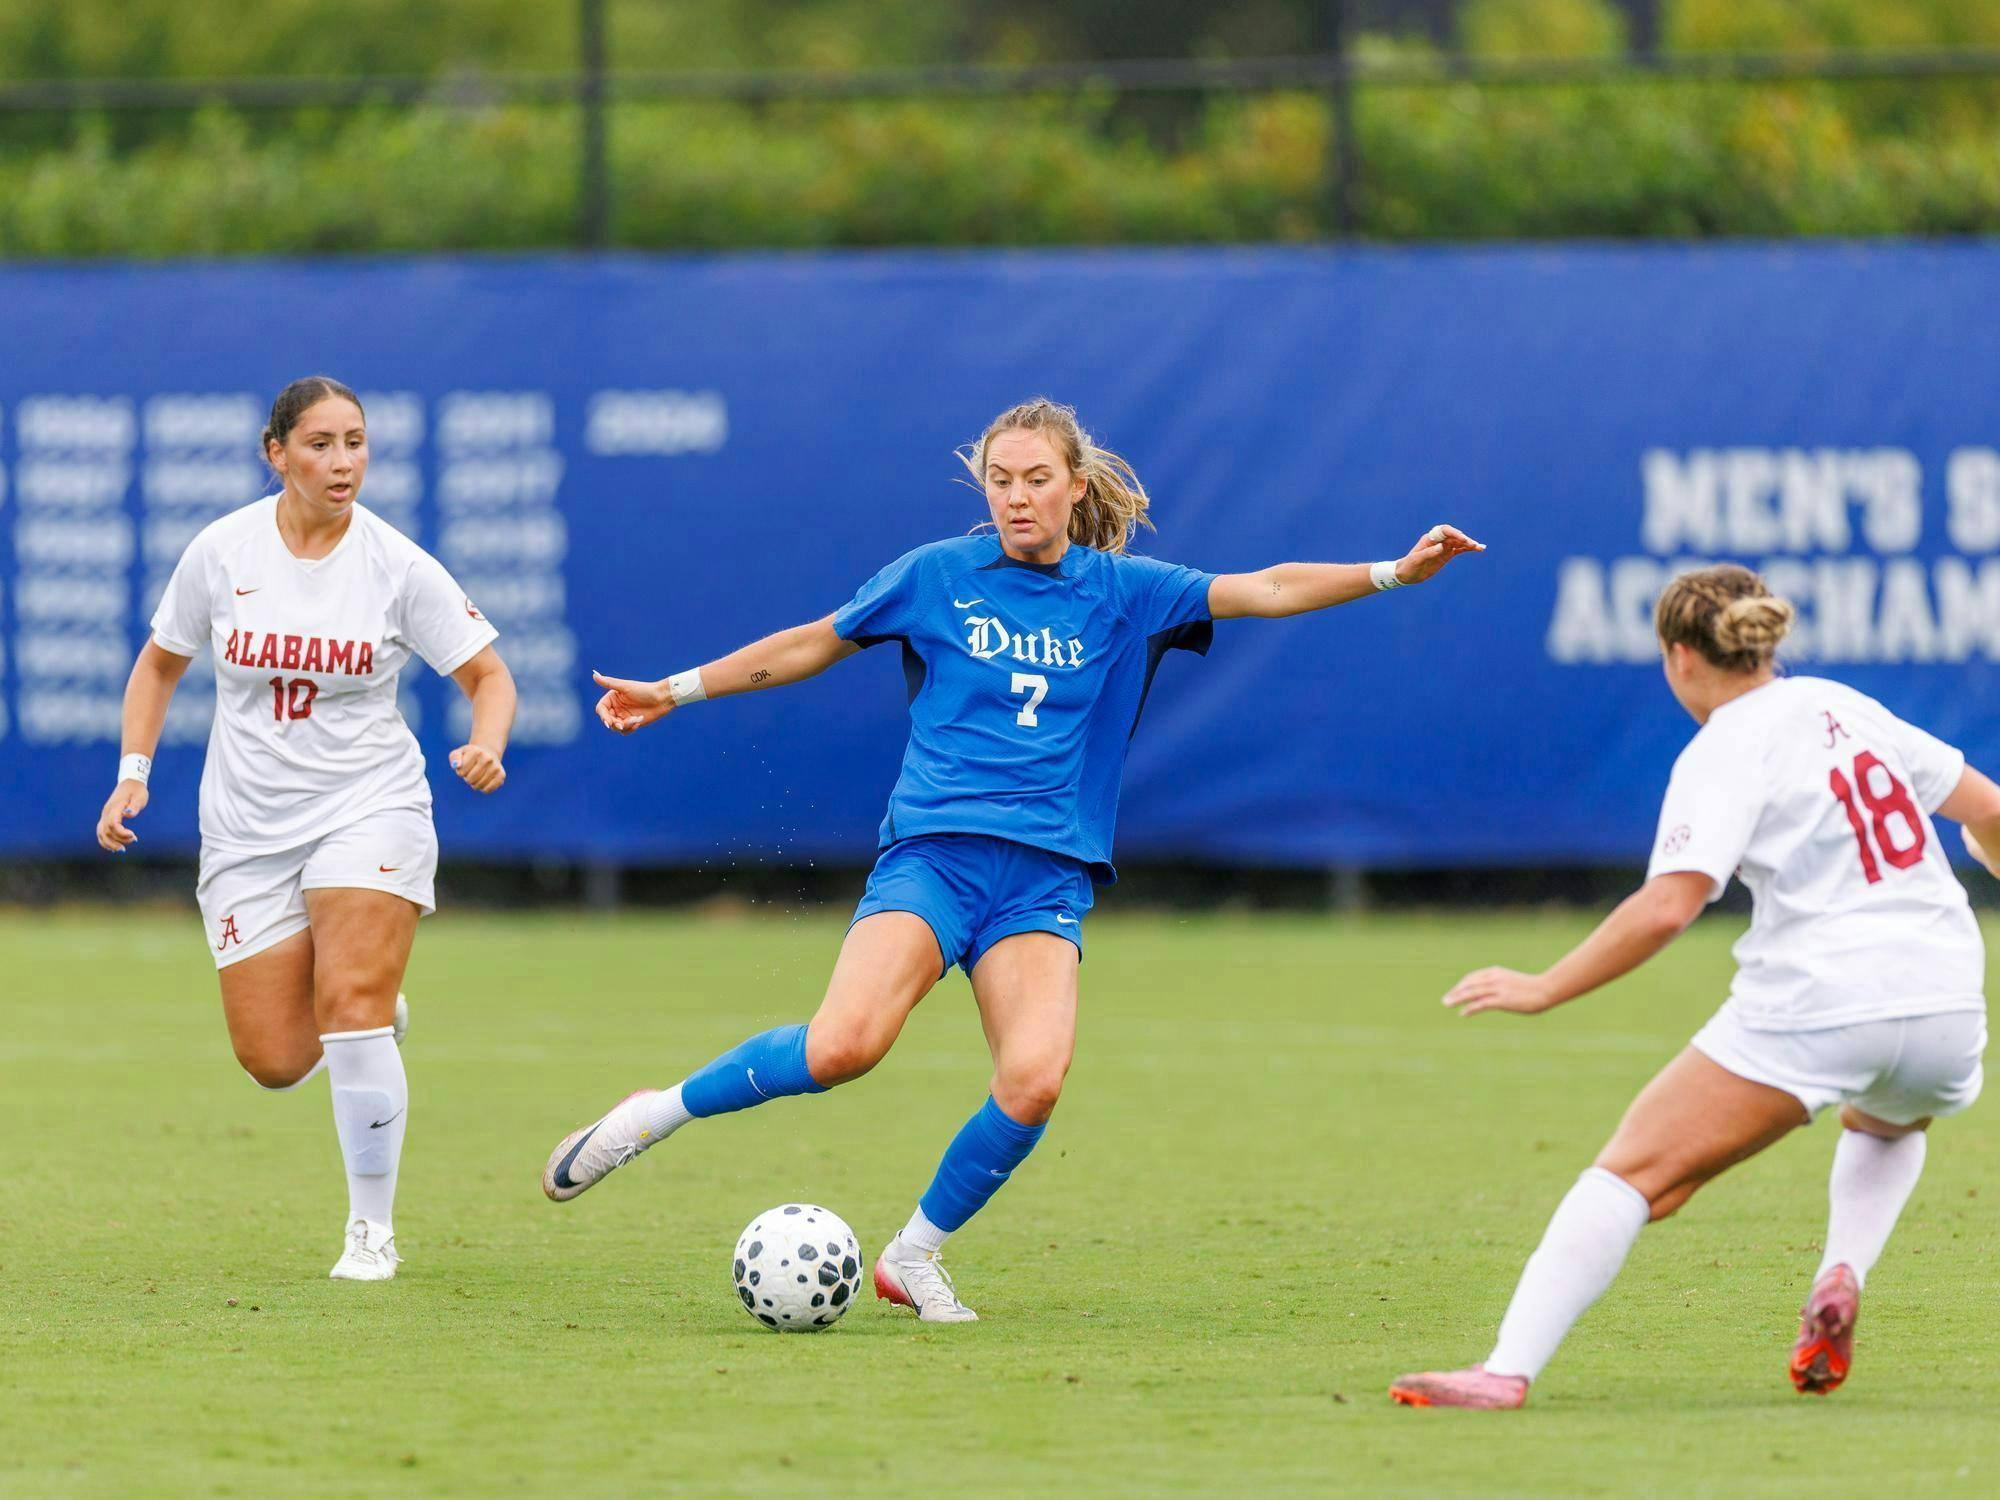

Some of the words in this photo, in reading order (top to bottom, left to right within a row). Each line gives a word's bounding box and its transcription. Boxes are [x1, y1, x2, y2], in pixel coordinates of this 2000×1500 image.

[225, 628, 374, 675] ALABAMA
[964, 616, 1085, 668] Duke
[269, 676, 319, 722] 10
[1010, 672, 1049, 728] 7
[1821, 710, 1850, 749] A
[1829, 750, 1926, 885] 18
[218, 914, 243, 951] A
